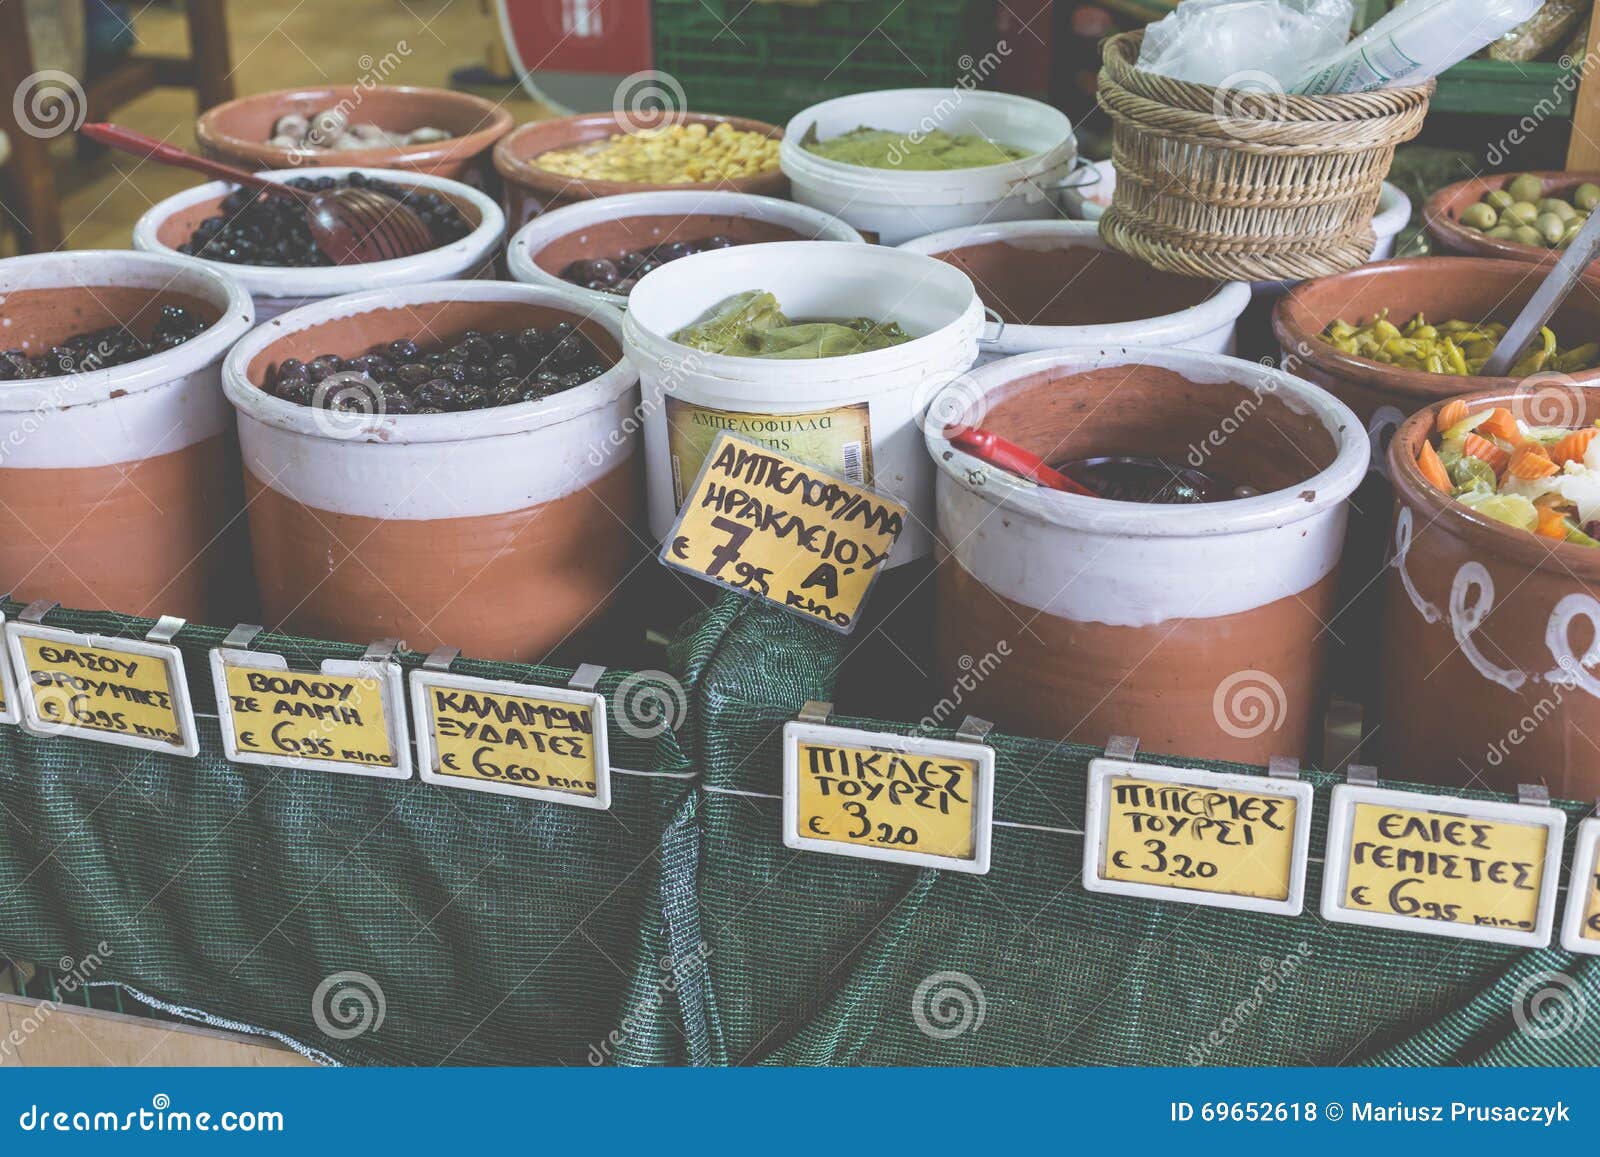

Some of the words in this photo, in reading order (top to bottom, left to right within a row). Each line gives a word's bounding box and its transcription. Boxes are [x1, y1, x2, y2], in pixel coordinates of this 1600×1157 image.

[702, 483, 889, 569] ΗΡΑΚΛΕΙΟΥ
[38, 646, 138, 678] ΘΑΣΟΥ
[247, 672, 353, 701] ΒΟΛΟΥ
[230, 695, 262, 712] ΣΕ
[273, 699, 363, 727] ΑΛΜΗ
[437, 717, 586, 759] ΞΥΔΑΤΕΣ
[805, 746, 968, 803] ΠΙΚΛΕΣ
[814, 776, 949, 815] ΤΟΥΡΣΙ
[1112, 784, 1285, 831] ΠΙΠΕΡΙΕΣ
[1123, 812, 1254, 845] ΤΟΥΡΣΙ
[1378, 813, 1494, 850] ΕΛΙΕΣ
[1353, 842, 1535, 890] ΓΕΜΙΣΤΕΣ
